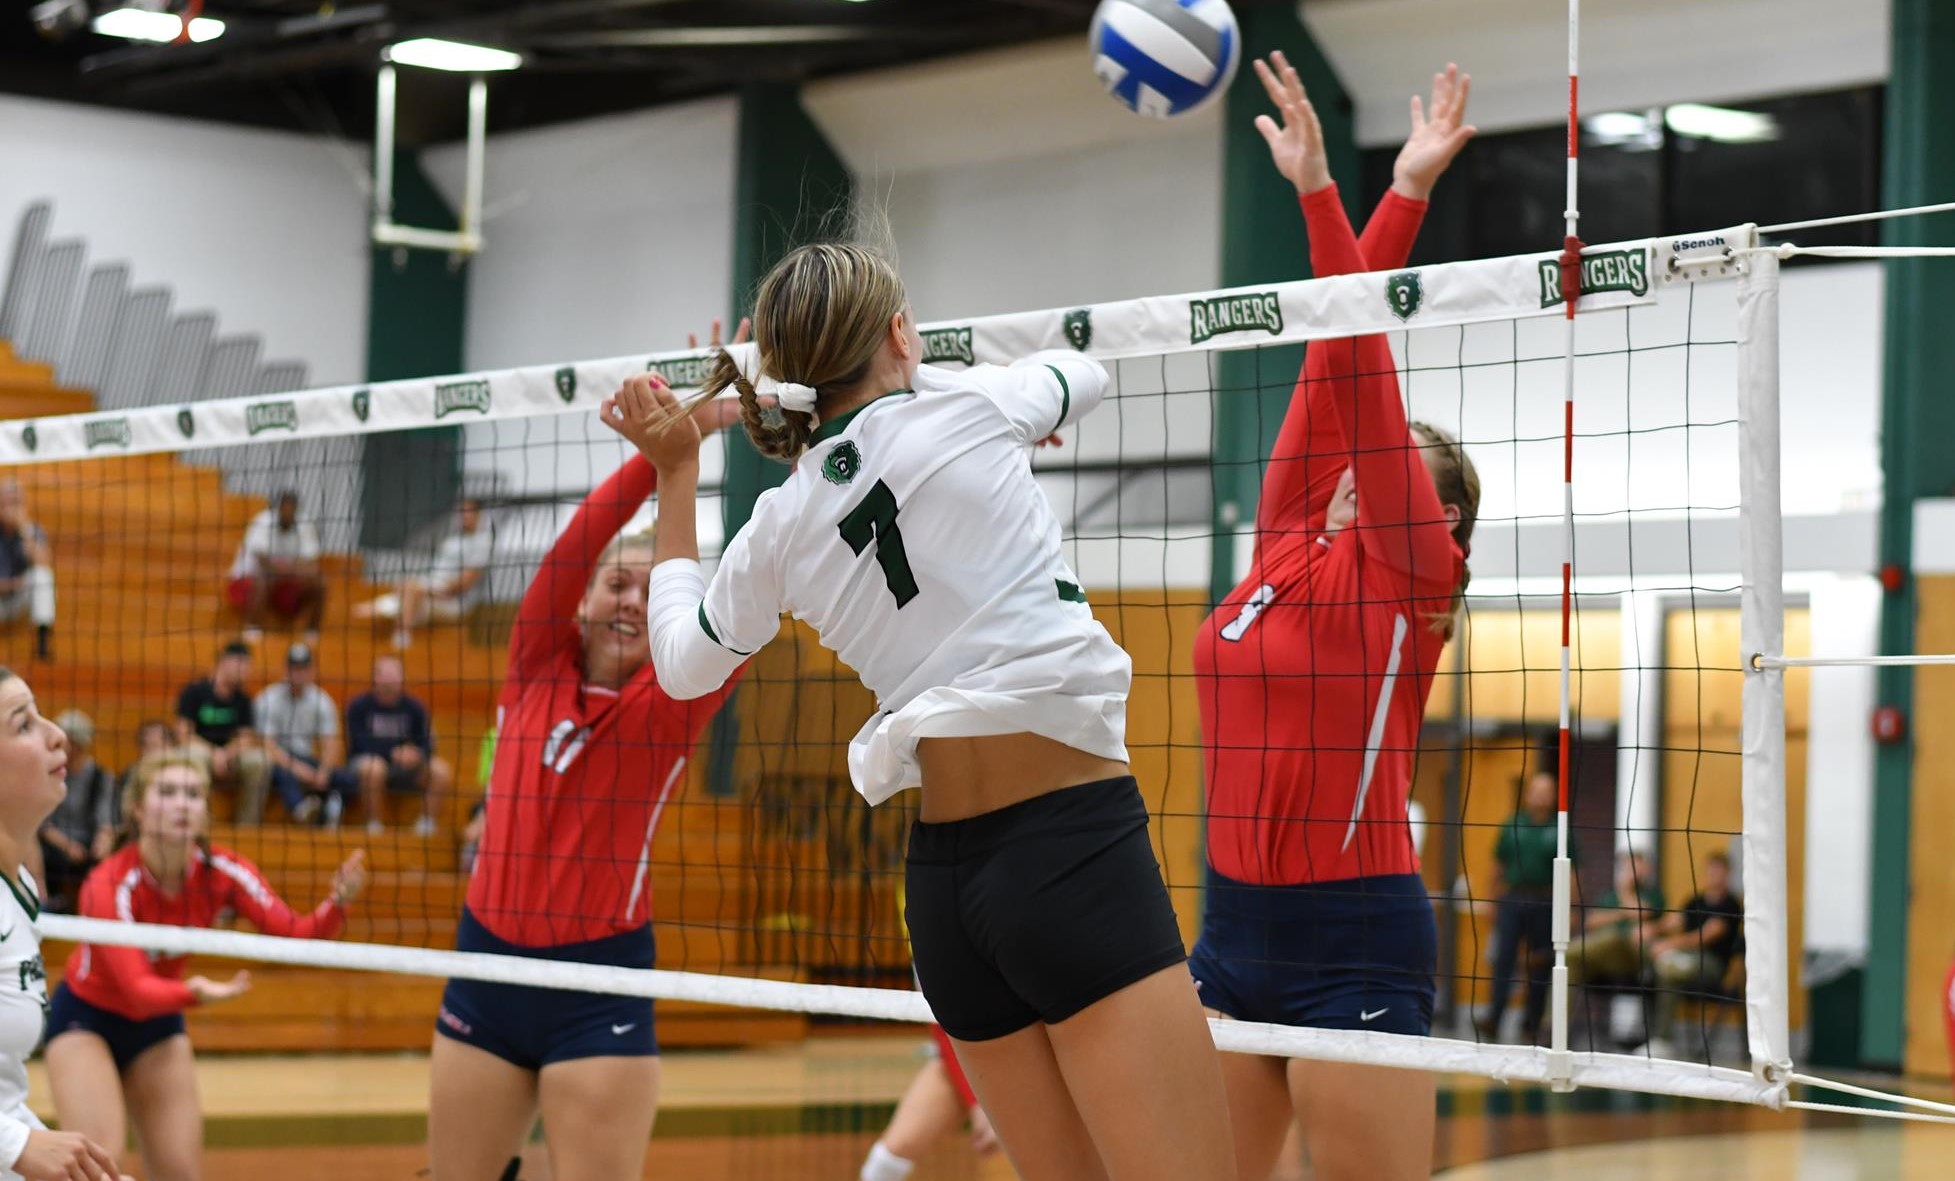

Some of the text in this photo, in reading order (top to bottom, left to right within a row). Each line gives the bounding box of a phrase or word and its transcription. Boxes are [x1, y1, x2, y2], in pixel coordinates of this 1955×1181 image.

[1541, 252, 1645, 302] RNGERS
[1192, 295, 1281, 340] RANGERS
[920, 328, 973, 363] NGERS
[837, 478, 919, 610] 7
